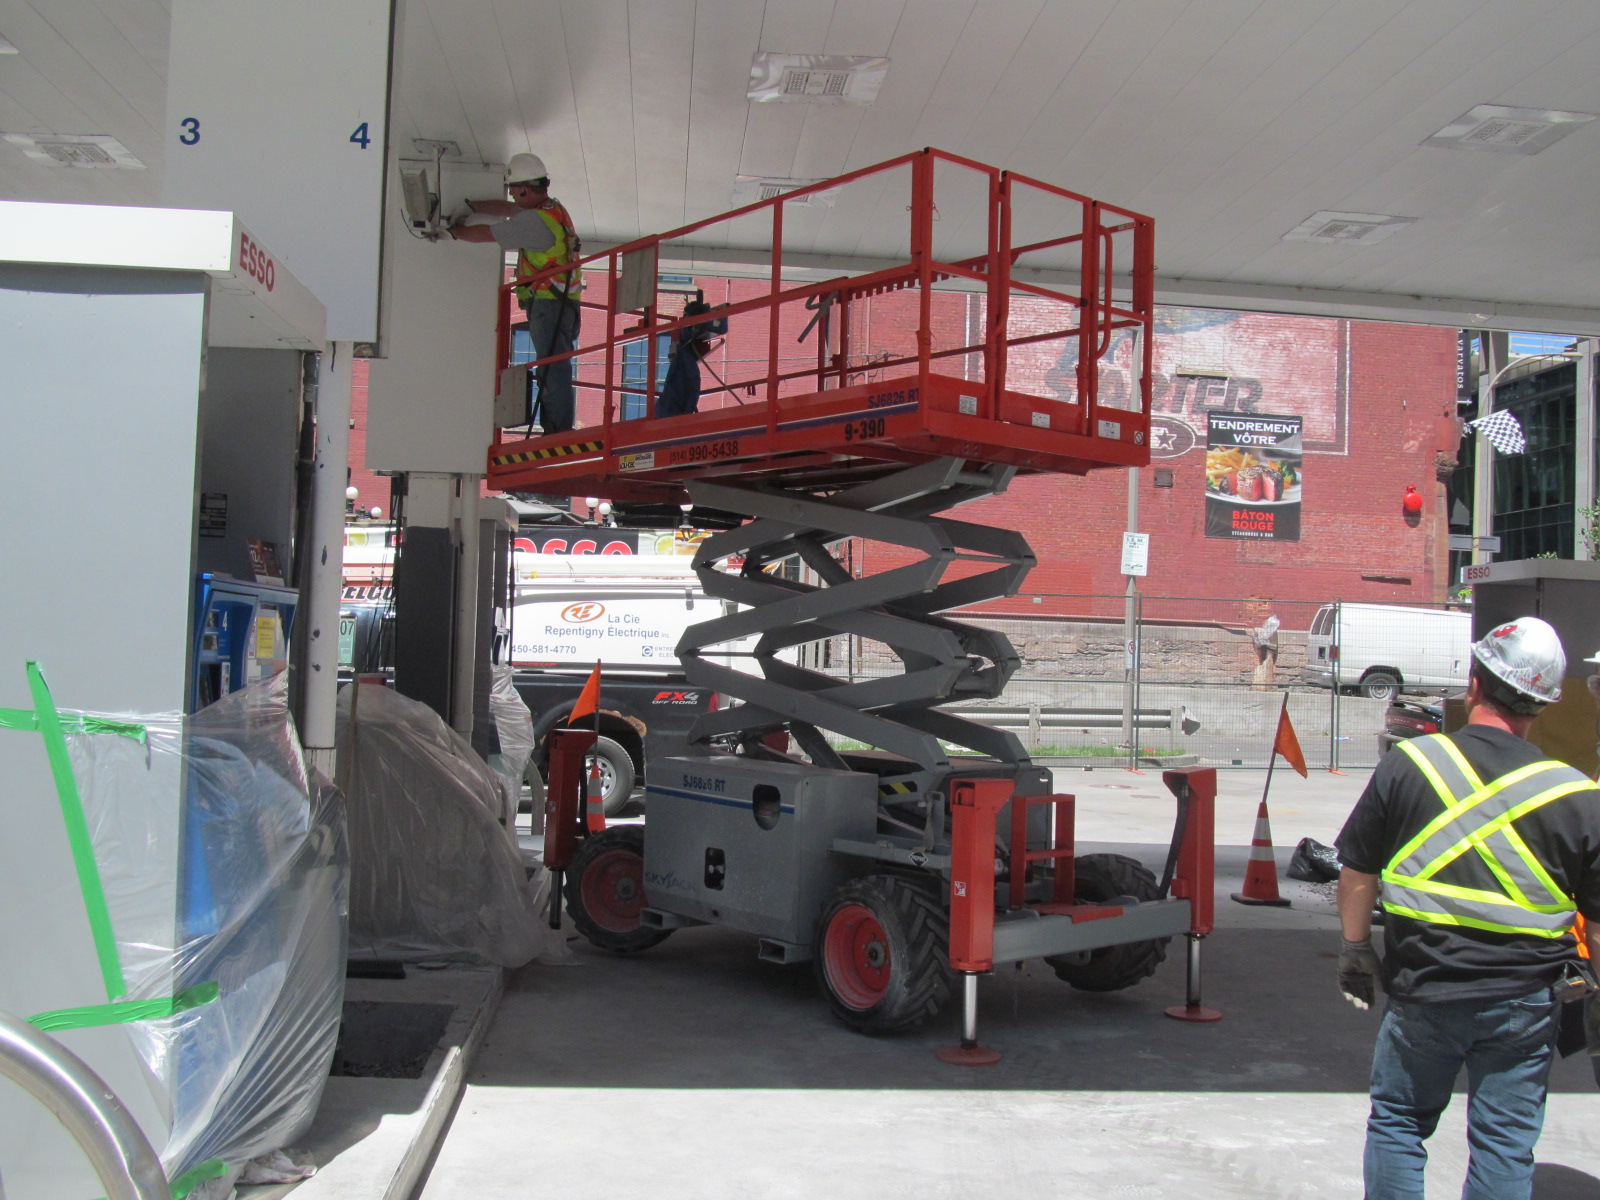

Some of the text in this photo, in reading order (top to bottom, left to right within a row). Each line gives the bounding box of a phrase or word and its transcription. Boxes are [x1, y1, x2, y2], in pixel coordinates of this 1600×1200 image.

[180, 118, 200, 145] 3
[350, 122, 371, 149] 4
[240, 232, 275, 292] ESSO
[868, 391, 904, 409] SJ6826
[845, 418, 885, 441] 9-390
[1210, 420, 1299, 434] TENDREMENT
[1233, 432, 1276, 445] VÔTRE
[688, 440, 739, 461] 990-5438
[1232, 509, 1275, 521] BÂTON
[1232, 520, 1275, 531] ROUGE
[1467, 566, 1490, 580] ESSO
[607, 614, 641, 624] La Cie
[545, 625, 605, 639] Repentigny
[607, 624, 660, 639] Électrique
[511, 644, 577, 654] 450-581-4770
[653, 691, 700, 701] FX4
[714, 779, 726, 792] RT
